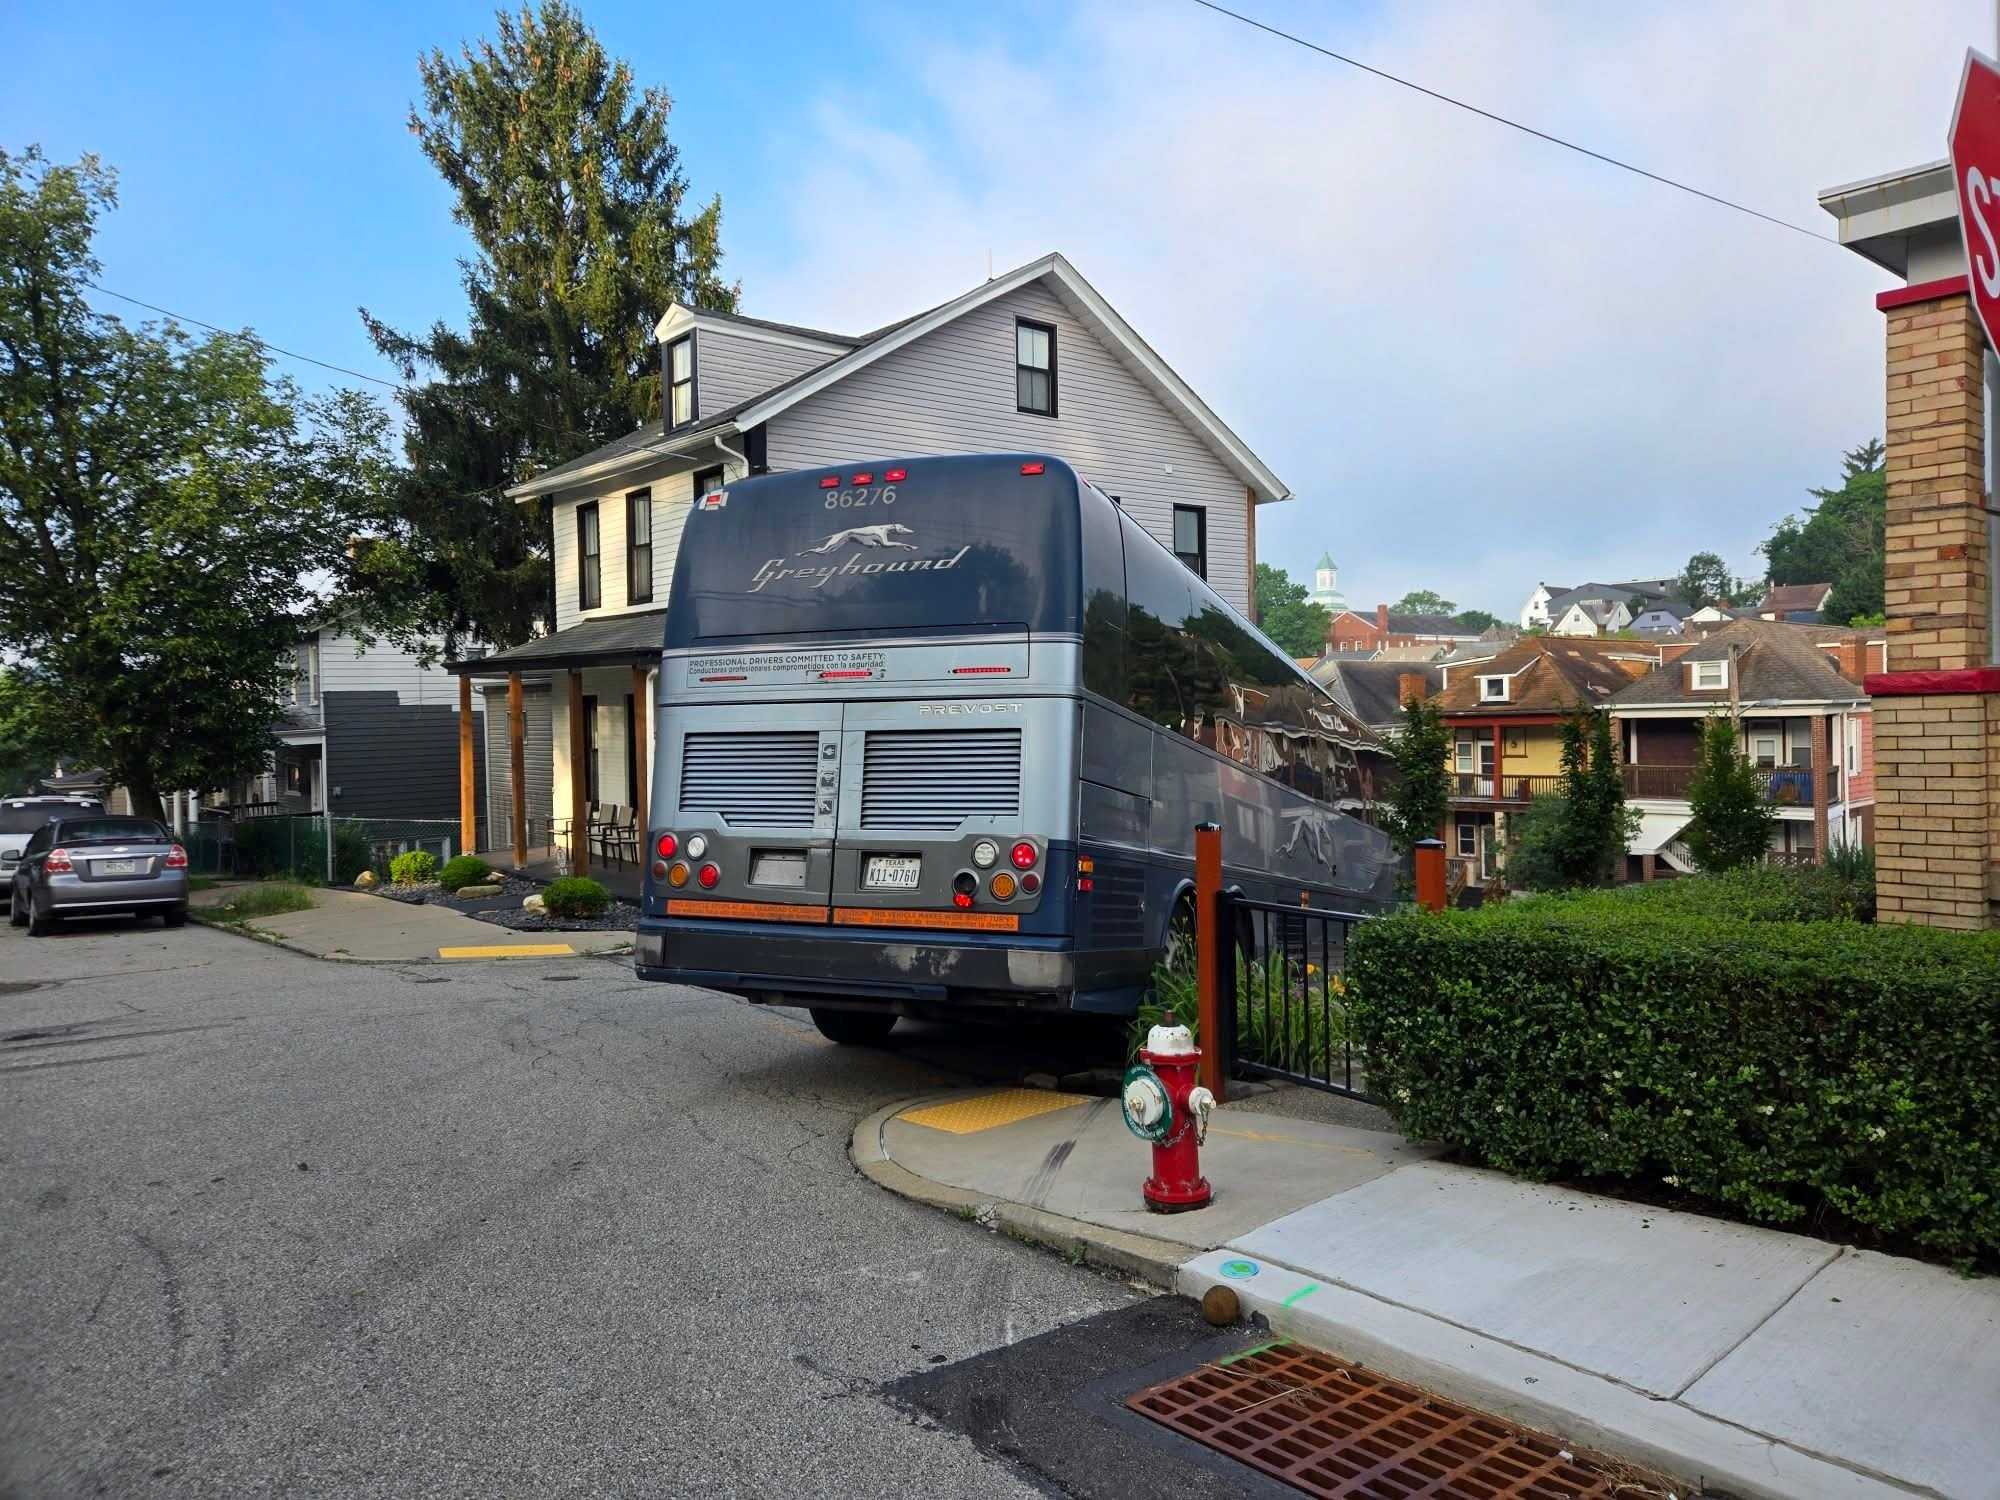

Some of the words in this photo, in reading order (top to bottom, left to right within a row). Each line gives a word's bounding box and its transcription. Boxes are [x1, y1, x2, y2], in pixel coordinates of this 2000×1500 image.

[825, 485, 896, 510] 86276
[747, 545, 971, 592] Greyhound
[689, 658, 747, 668] PROFESSIONAL
[750, 657, 784, 666] DRIVERS
[786, 655, 834, 664] COMMITTED
[837, 654, 849, 662] TO
[689, 666, 727, 675] Conductores
[729, 665, 771, 674] profesionales
[773, 662, 825, 673] comprometidos
[840, 661, 847, 669] la
[919, 703, 1022, 716] PREVOST
